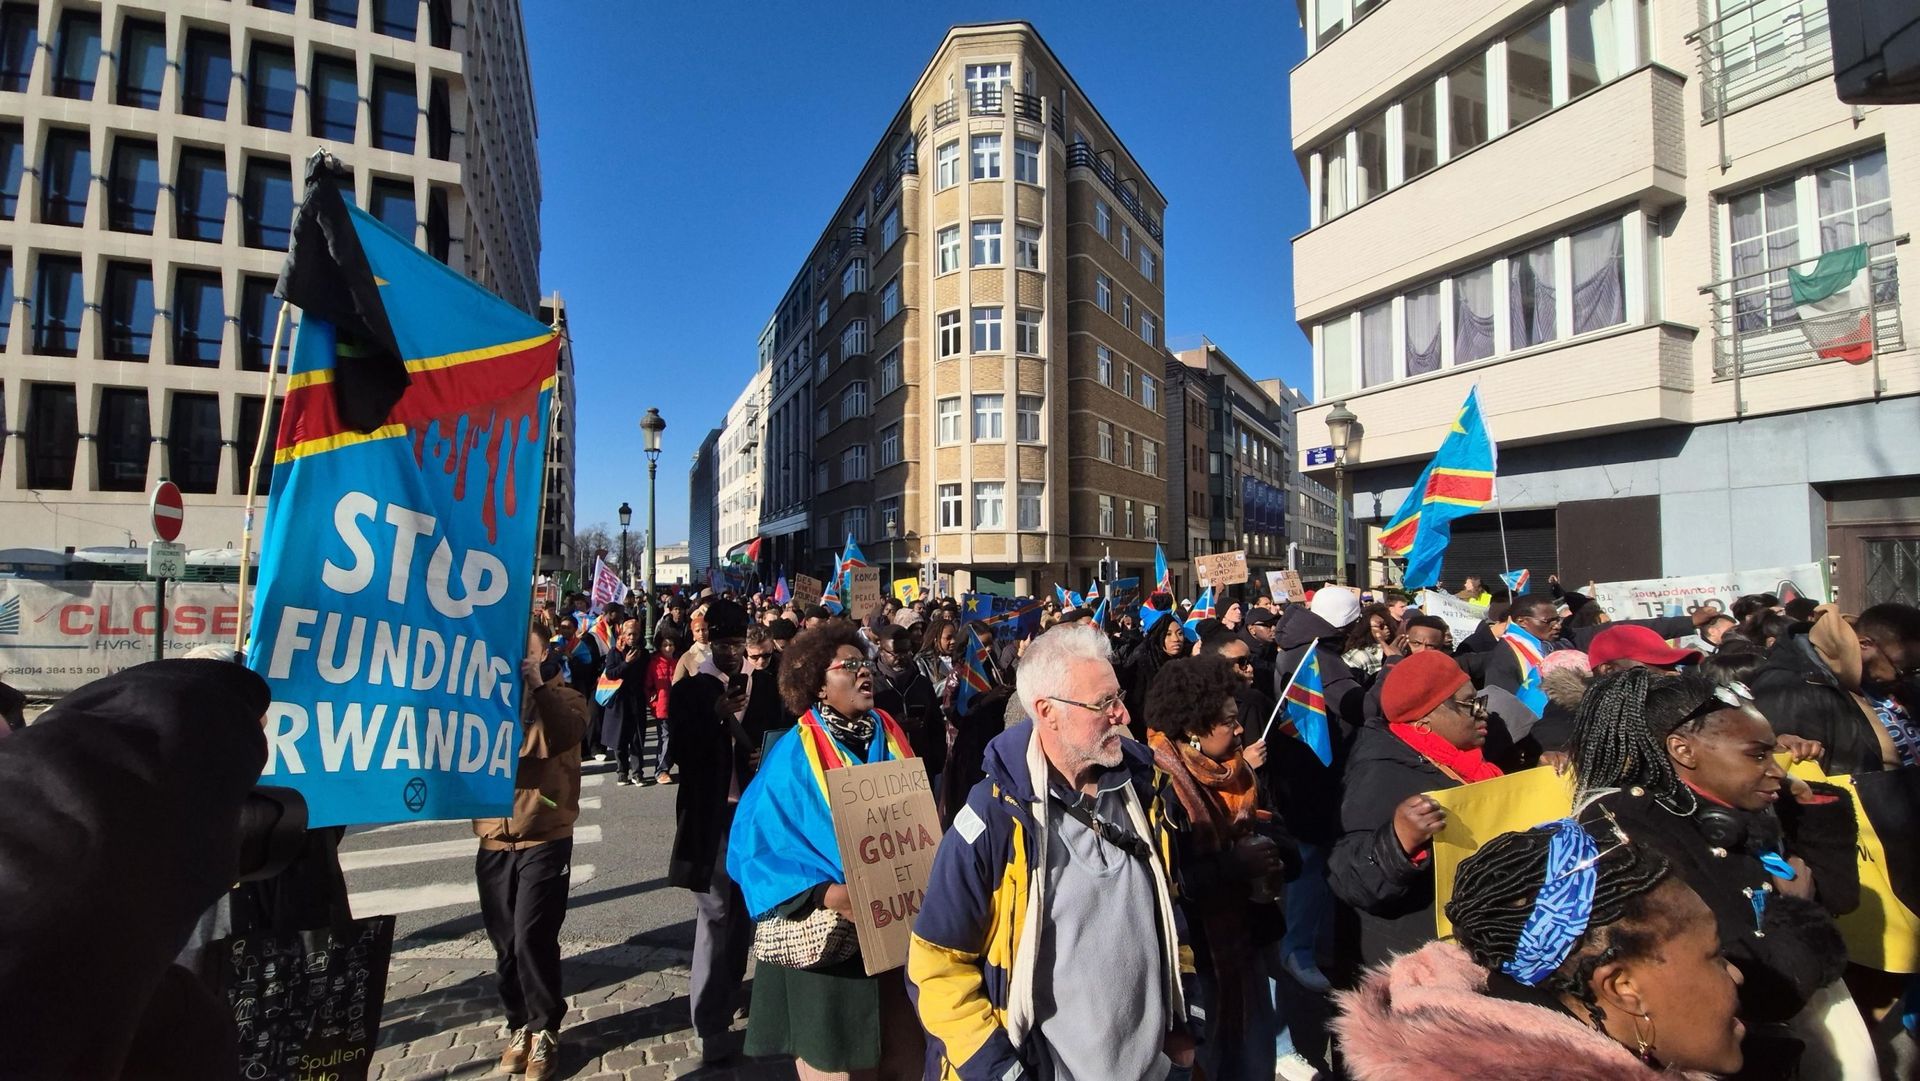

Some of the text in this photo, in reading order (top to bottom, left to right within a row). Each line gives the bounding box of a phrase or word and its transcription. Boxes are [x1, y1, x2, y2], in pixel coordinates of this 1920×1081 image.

[322, 491, 509, 619] STOP
[1634, 584, 1741, 599] uw bouwpartner
[96, 639, 142, 650] HVAC
[267, 606, 513, 708] FUNDING
[46, 667, 66, 675] 384
[69, 667, 83, 675] 53
[86, 667, 100, 675] 90
[261, 701, 515, 779] RWANDA
[841, 769, 930, 805] SOLIDAIRE
[867, 800, 912, 825] AVEC
[859, 823, 935, 865] GOMA
[895, 864, 913, 883] ET
[869, 887, 927, 929] BUK
[299, 1047, 366, 1074] Spullen
